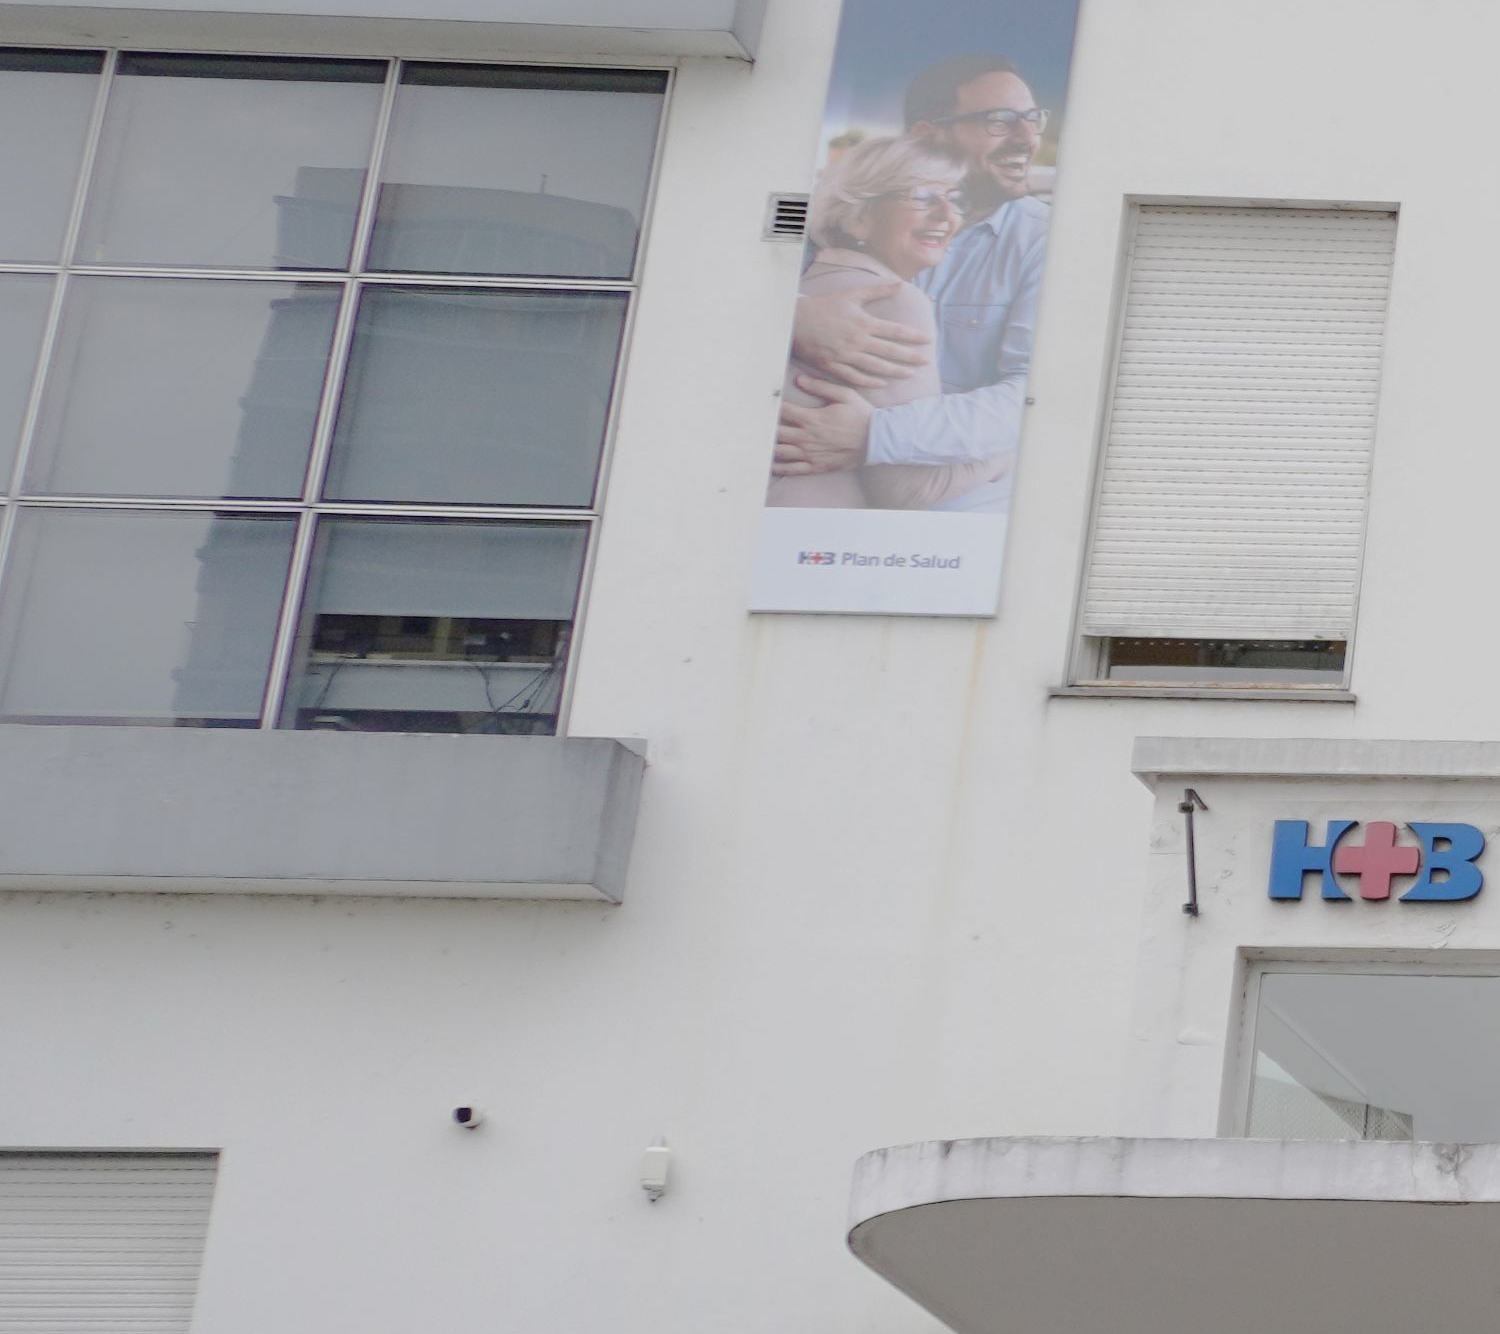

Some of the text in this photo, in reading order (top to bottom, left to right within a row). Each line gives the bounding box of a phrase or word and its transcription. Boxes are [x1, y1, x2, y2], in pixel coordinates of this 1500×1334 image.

[841, 552, 880, 567] Plan
[883, 553, 906, 568] de
[910, 554, 961, 569] Salud
